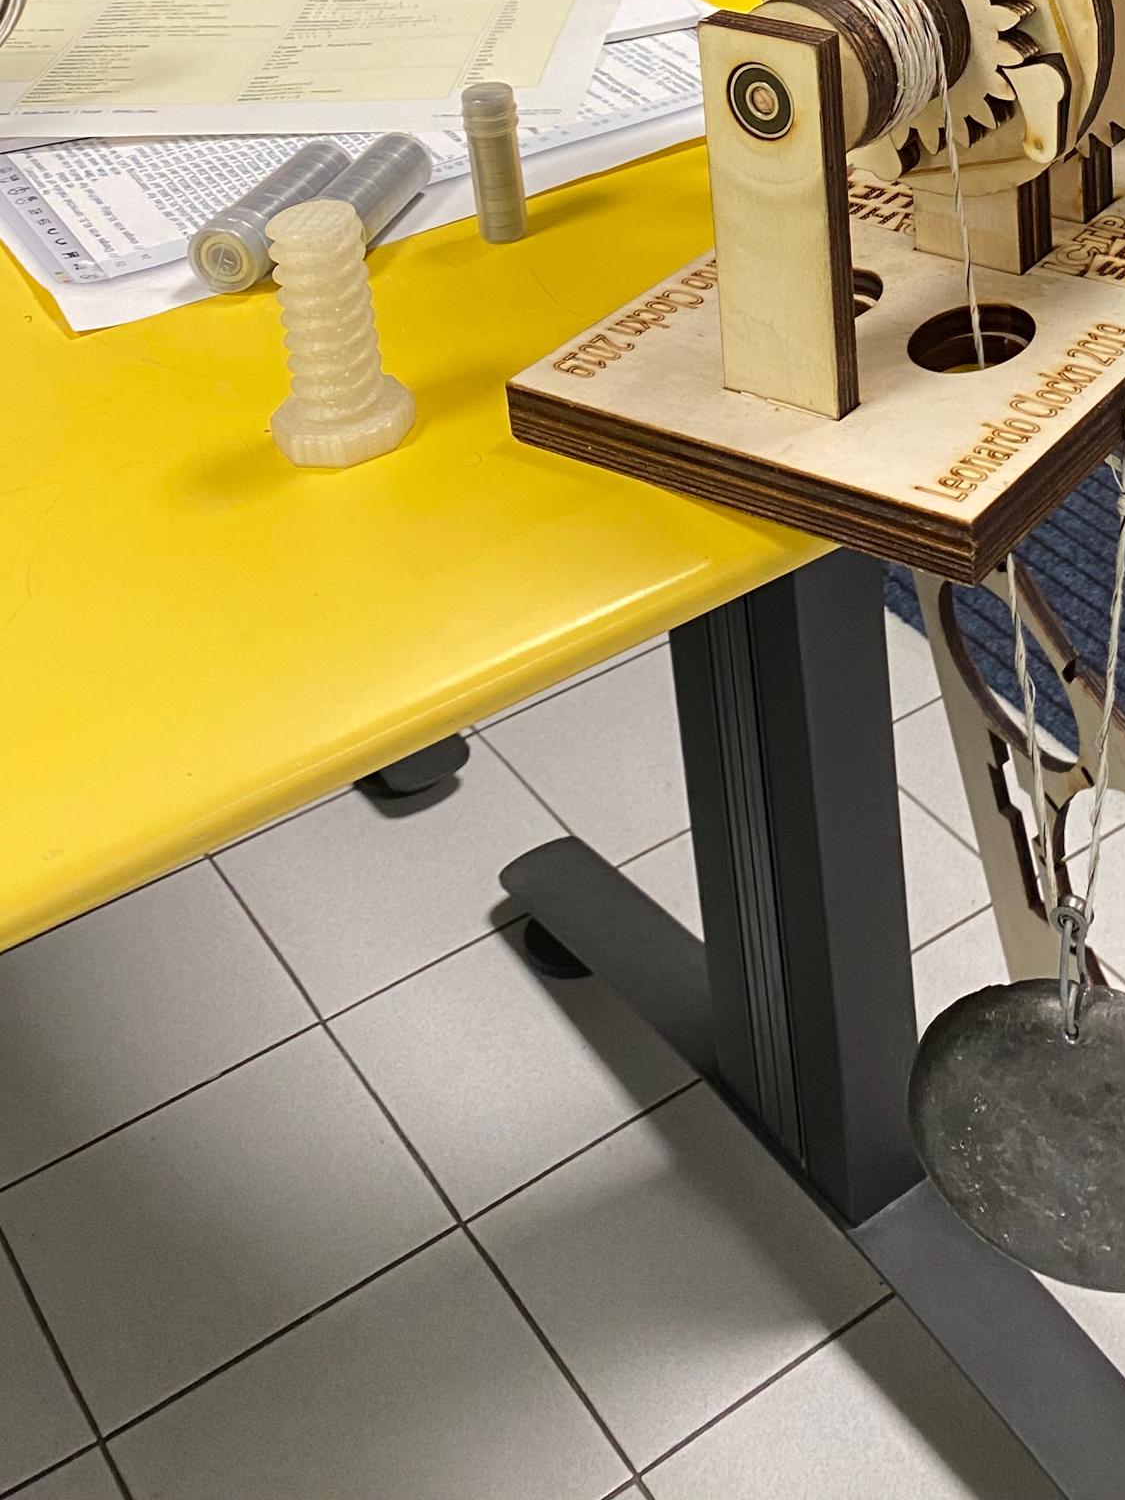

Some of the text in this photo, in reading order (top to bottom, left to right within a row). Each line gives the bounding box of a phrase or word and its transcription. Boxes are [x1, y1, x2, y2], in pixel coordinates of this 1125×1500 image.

[553, 289, 705, 378] Clockn 2019
[912, 417, 1042, 503] Leonardo
[1009, 363, 1103, 419] Clockn
